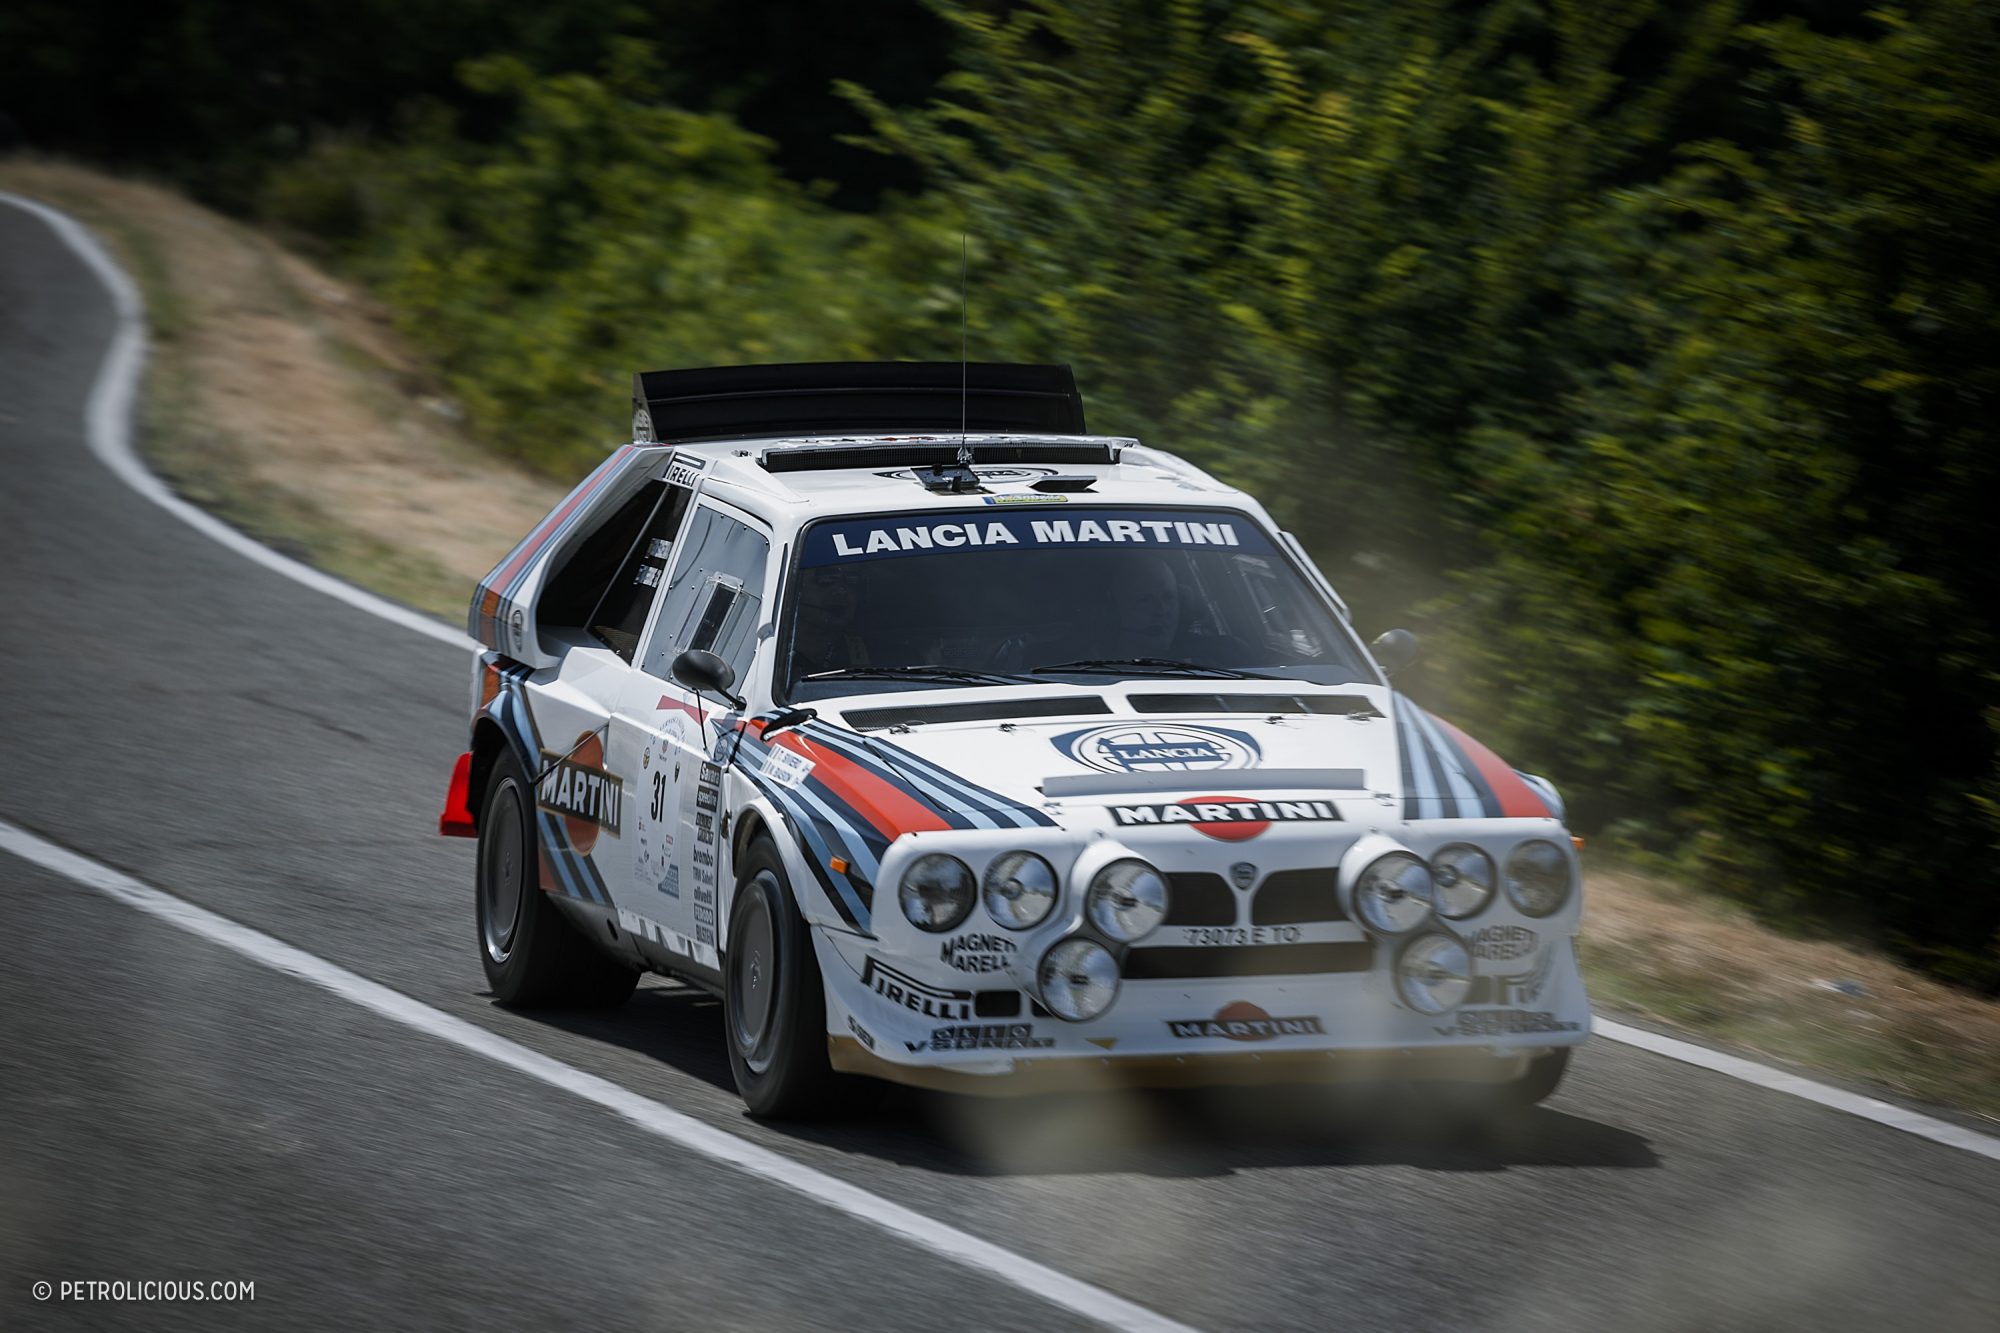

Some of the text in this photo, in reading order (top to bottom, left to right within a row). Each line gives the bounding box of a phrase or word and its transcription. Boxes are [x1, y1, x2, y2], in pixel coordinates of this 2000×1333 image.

[662, 451, 706, 487] PIRELLI
[832, 520, 1240, 557] LANCIA MARTINI
[1117, 747, 1217, 760] LANCIA
[541, 760, 619, 827] MARTINI
[651, 770, 666, 823] 31
[1115, 801, 1335, 825] MARTINI
[941, 933, 1017, 957] MAGNETI
[1187, 926, 1300, 945] 73073 E TO
[860, 954, 971, 1020] PIRELLI
[1174, 1017, 1325, 1038] MARTINI
